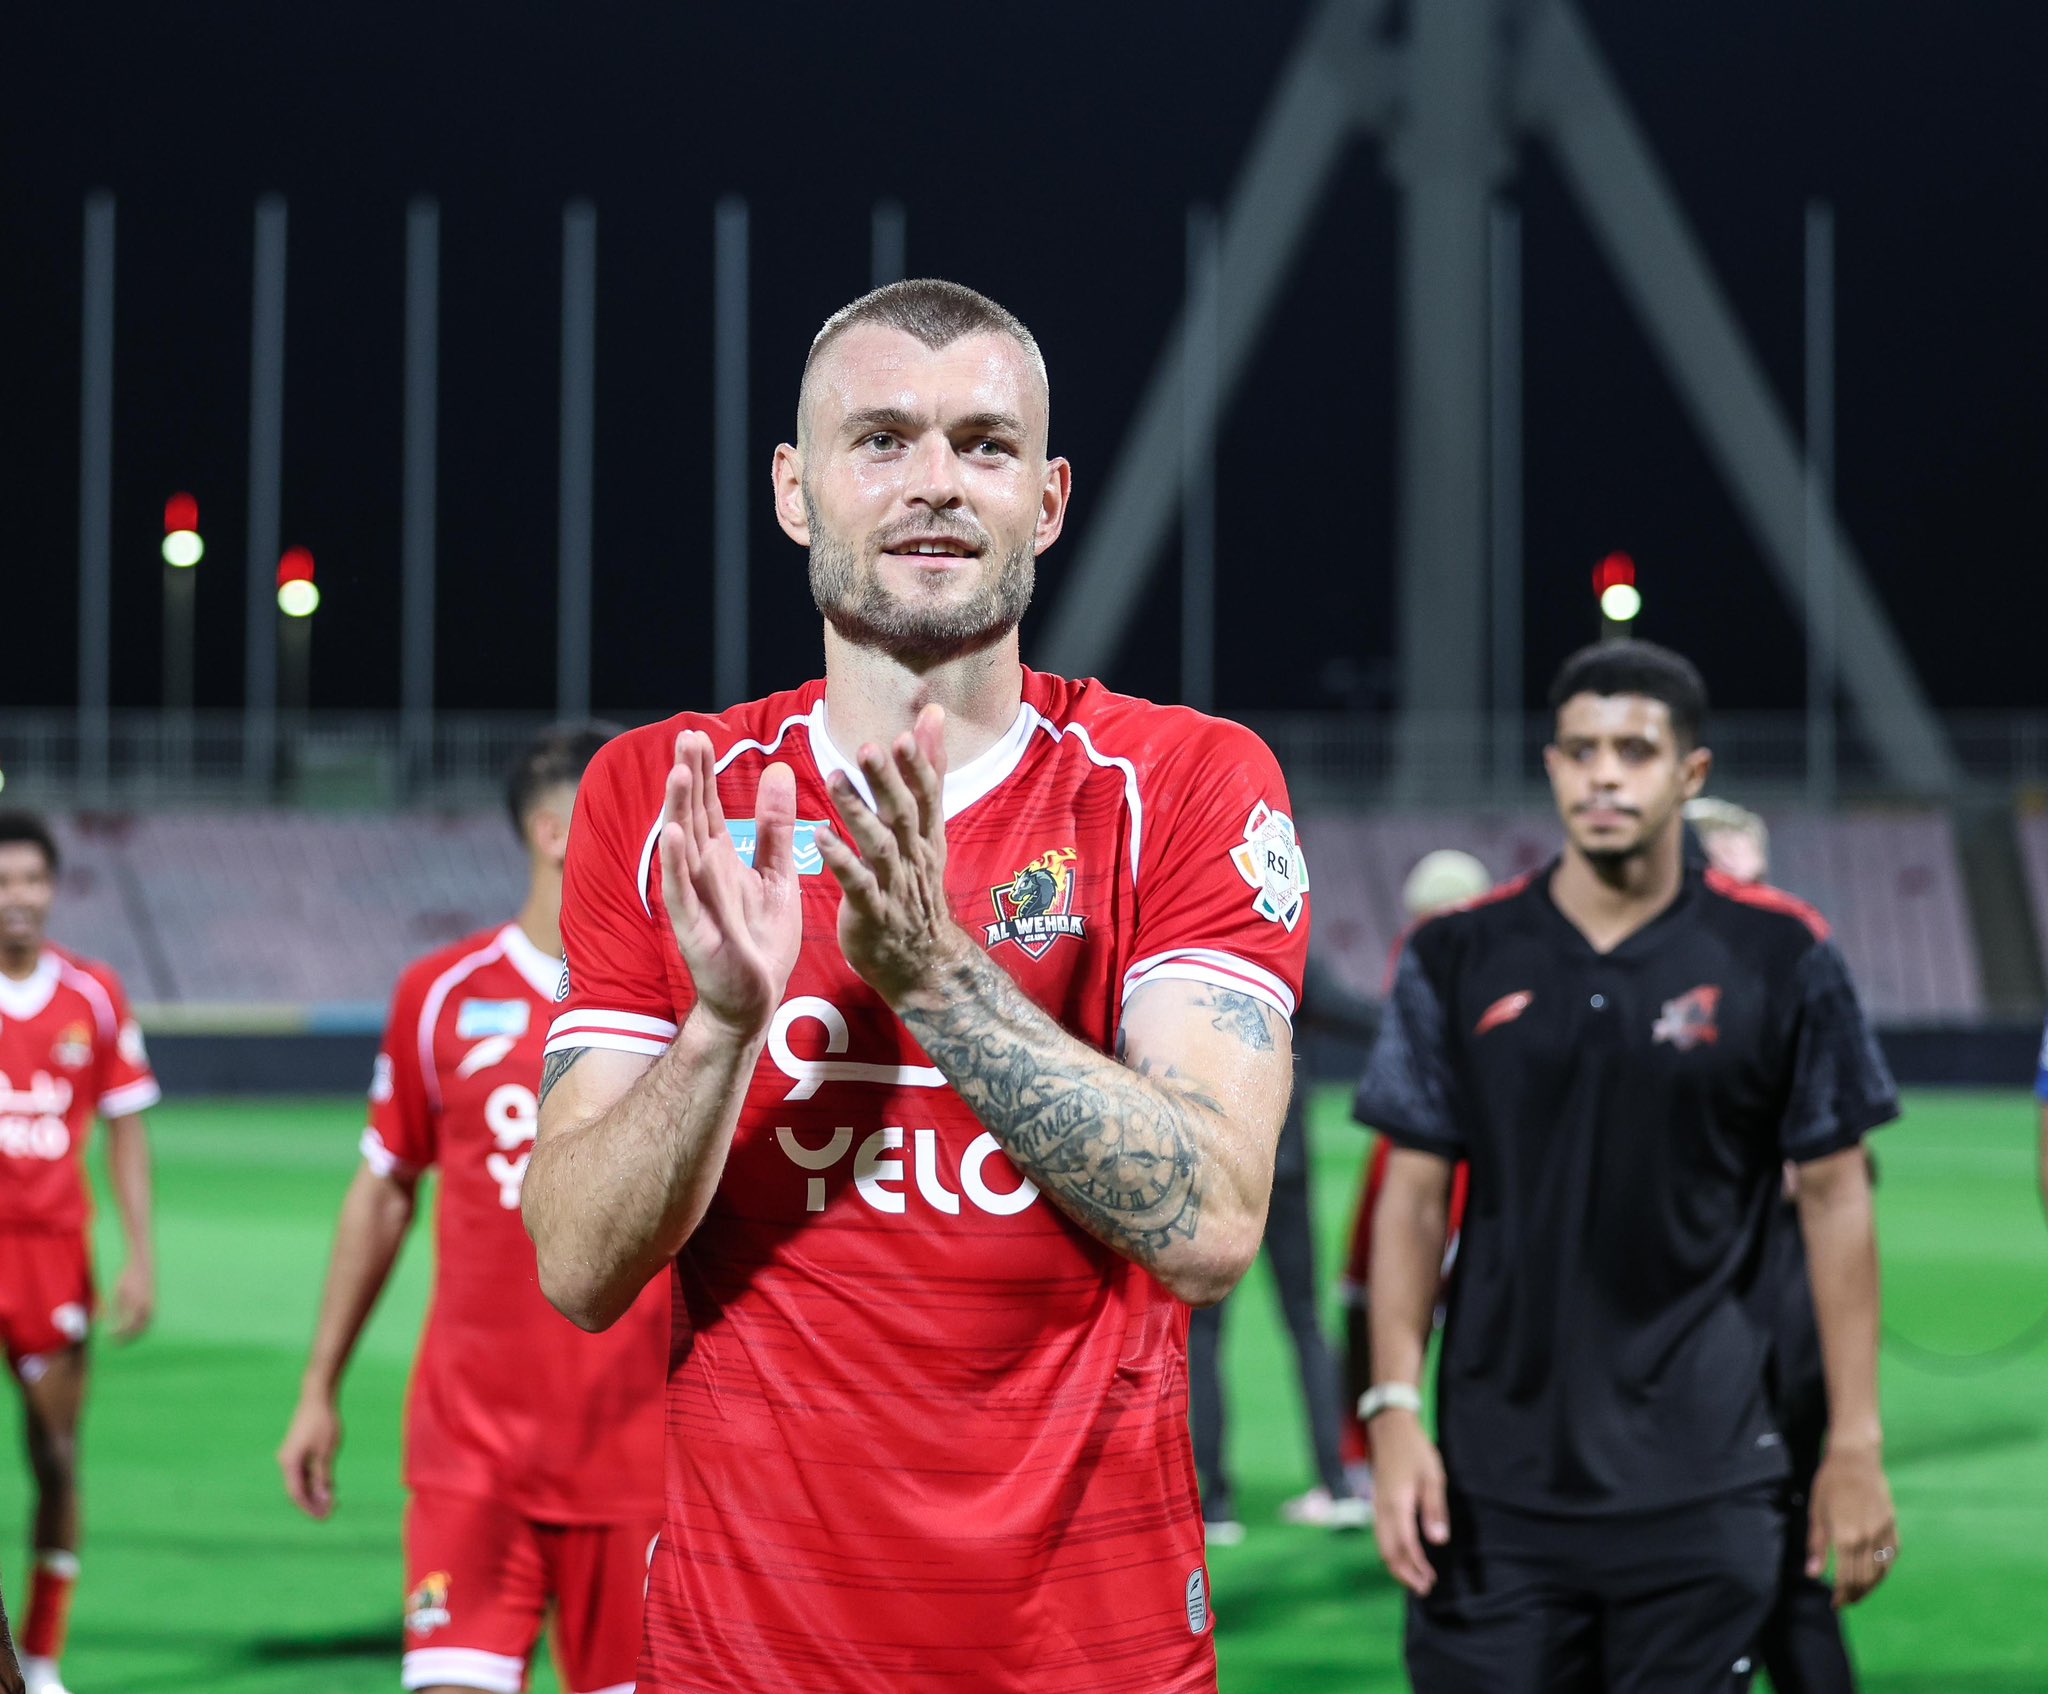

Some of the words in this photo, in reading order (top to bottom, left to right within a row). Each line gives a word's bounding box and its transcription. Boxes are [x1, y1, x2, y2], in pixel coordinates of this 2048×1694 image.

[1266, 849, 1290, 880] RSL
[985, 921, 1010, 946] AL
[1014, 915, 1084, 936] WEHDA
[1023, 932, 1048, 943] CLUB
[775, 1126, 1041, 1215] YELO
